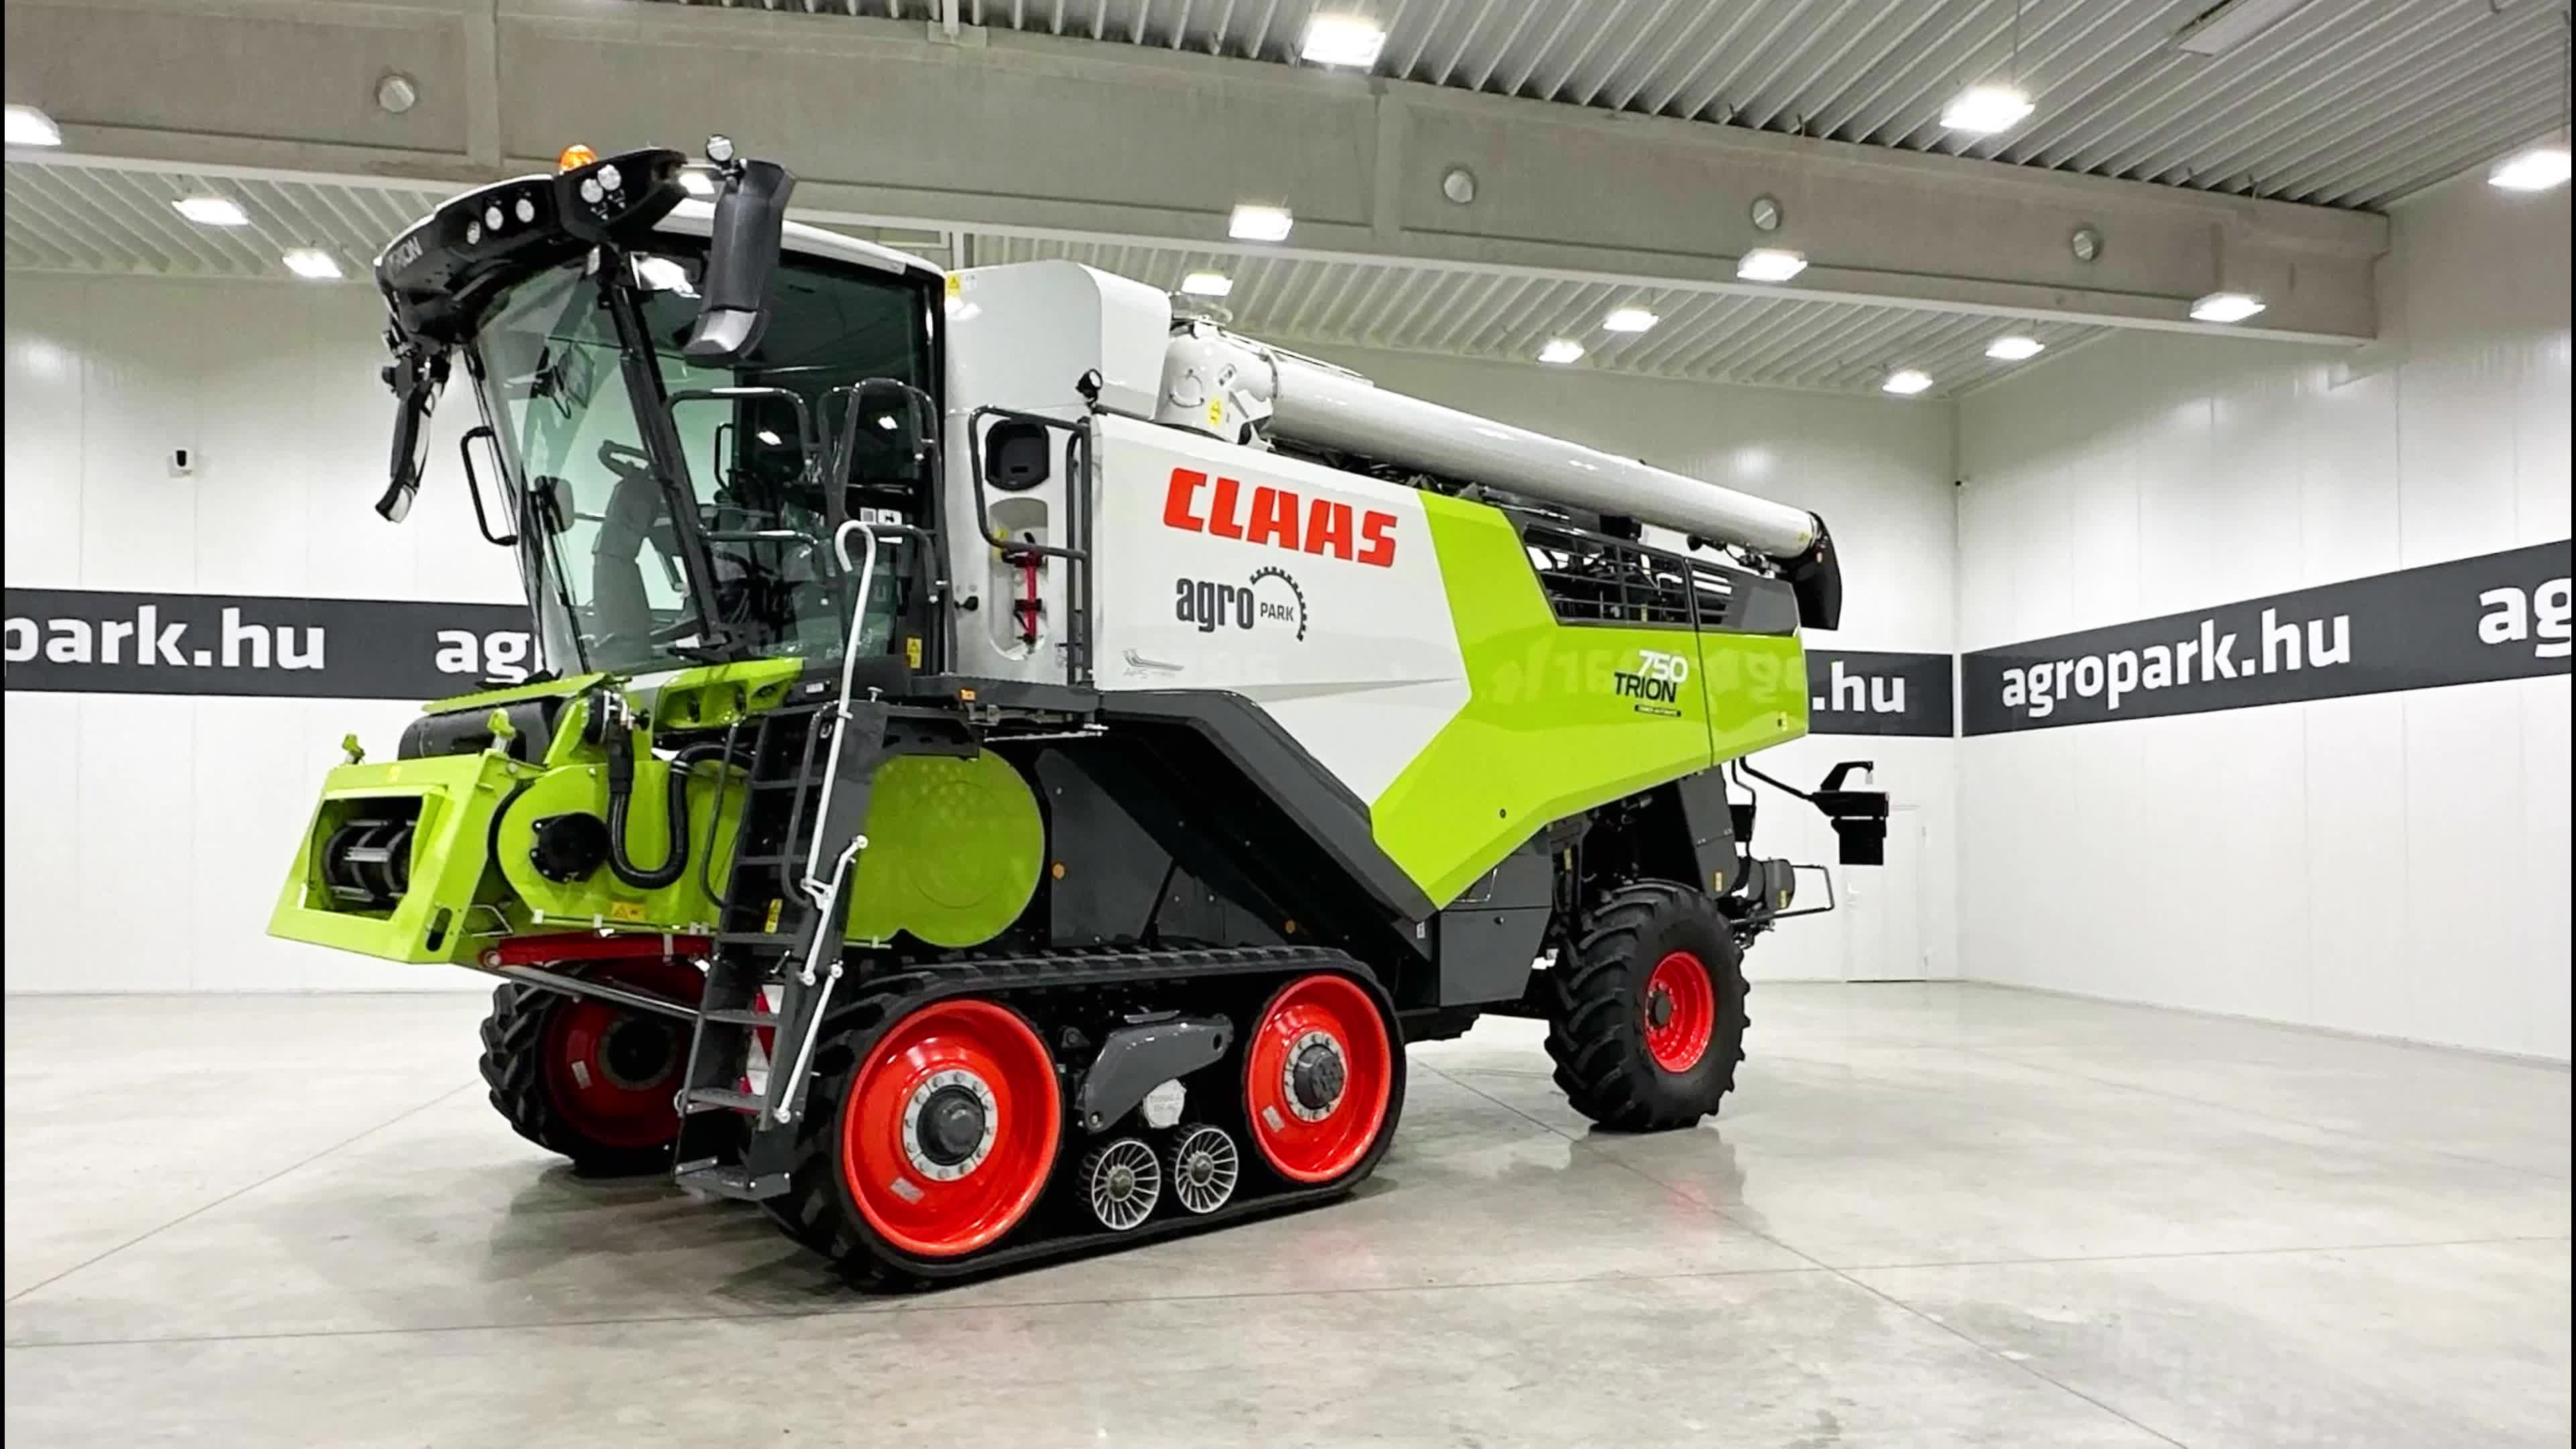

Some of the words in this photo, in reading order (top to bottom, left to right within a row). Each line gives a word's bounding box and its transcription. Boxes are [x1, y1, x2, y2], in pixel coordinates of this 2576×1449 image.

[1164, 468, 1397, 568] CLAAS
[1176, 578, 1254, 633] agro
[1260, 602, 1294, 622] PARK
[1613, 672, 1678, 703] TRION
[1639, 649, 1688, 683] 750
[2002, 608, 2350, 718] agropark.hu
